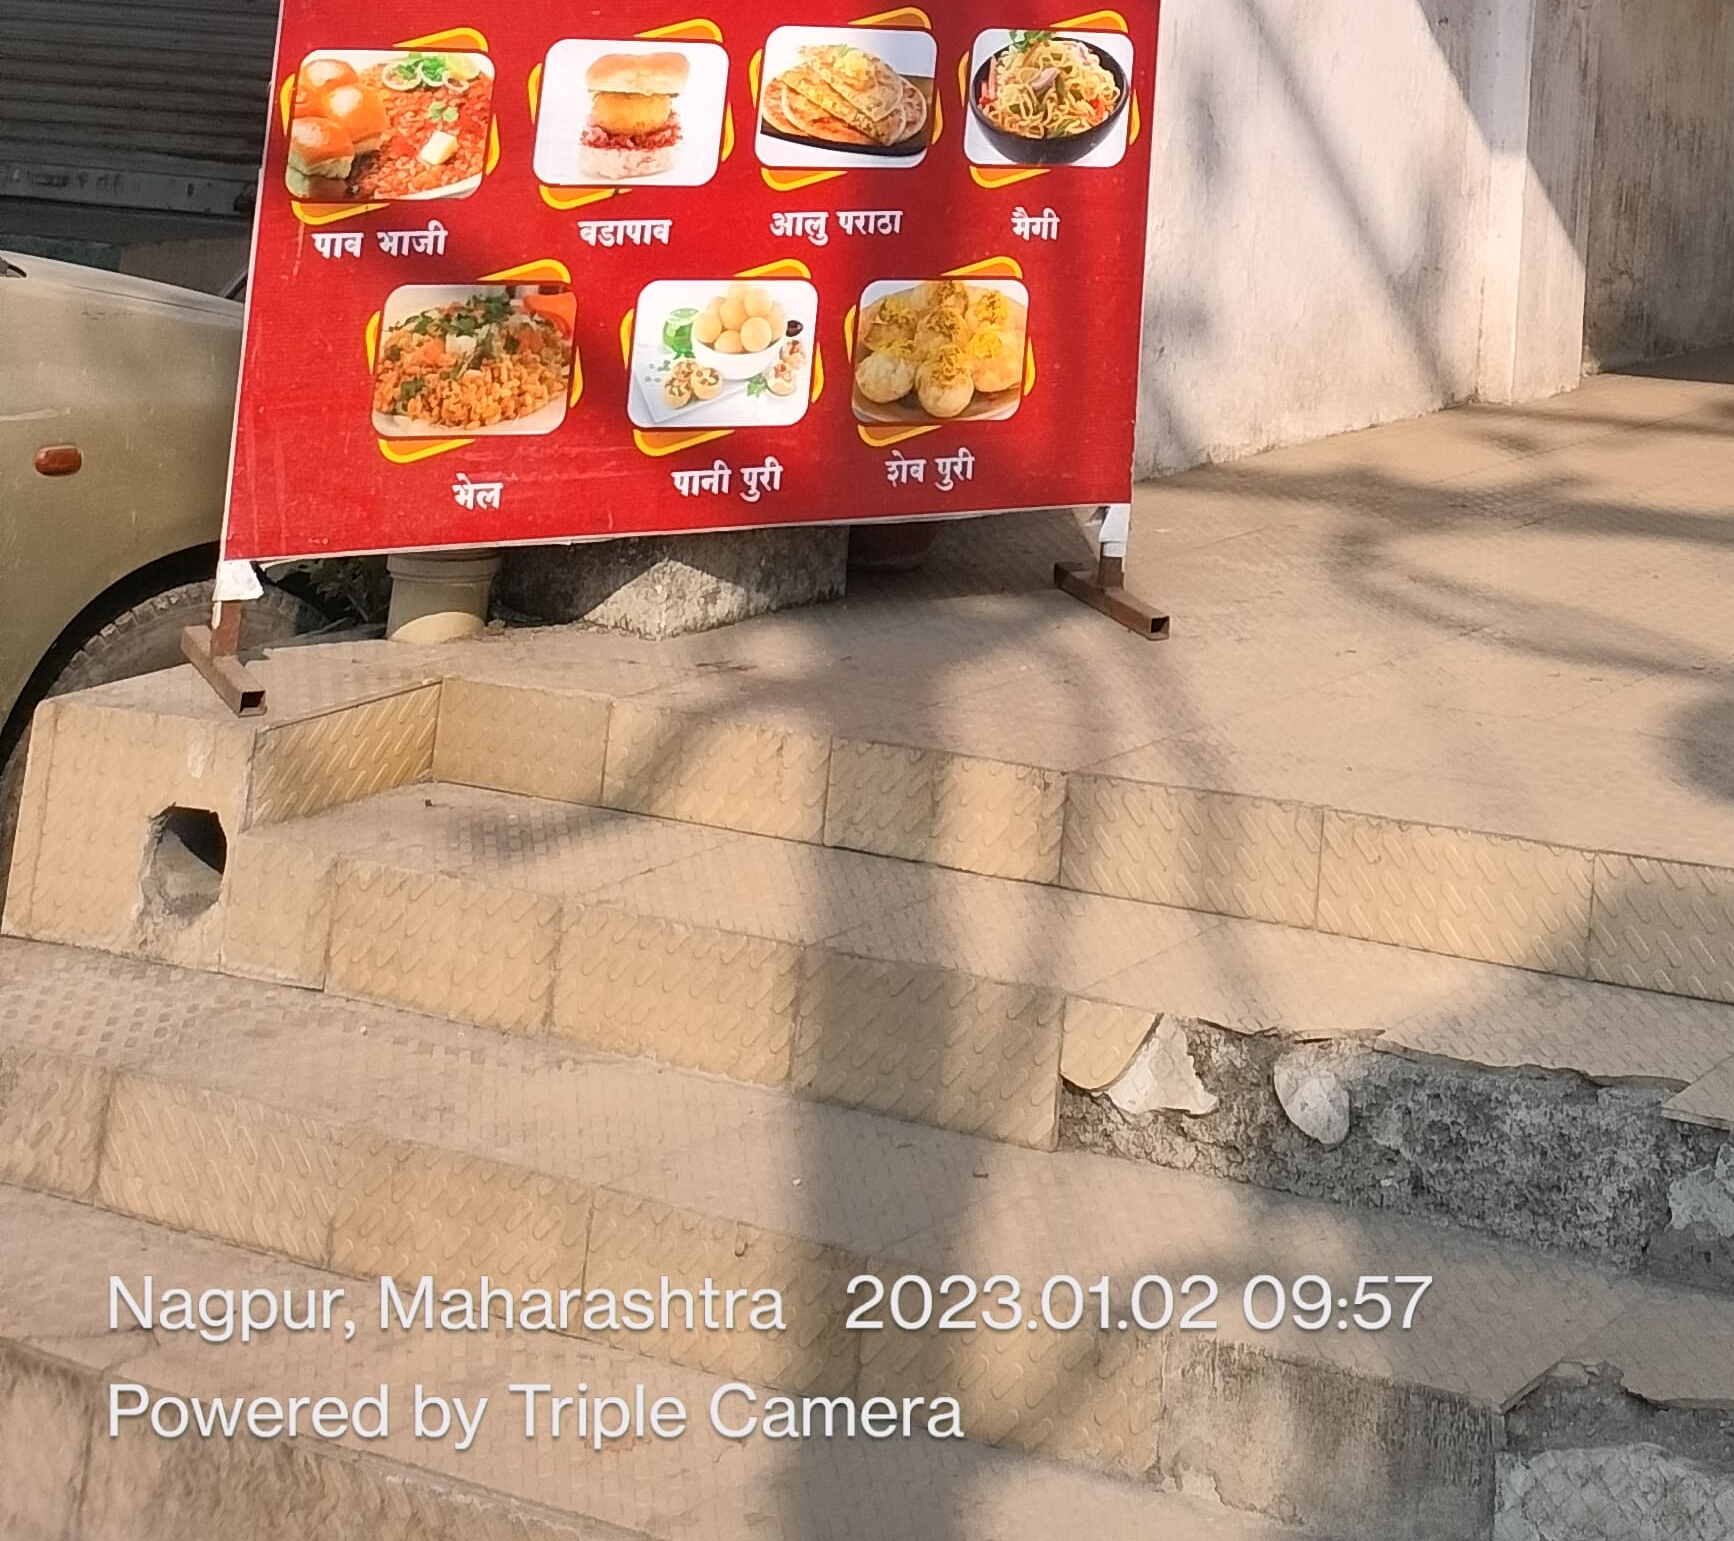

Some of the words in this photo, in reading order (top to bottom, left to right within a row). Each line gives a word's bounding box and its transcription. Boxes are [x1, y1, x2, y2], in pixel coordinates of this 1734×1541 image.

[311, 231, 364, 259] पाव
[377, 219, 448, 257] भाजी
[576, 218, 673, 248] वडापाव
[769, 210, 829, 246] आलु
[836, 210, 904, 235] पराठा
[1009, 206, 1061, 241] मैगी
[671, 459, 731, 498] पानी
[740, 455, 784, 503] पुरी
[885, 449, 927, 489] शेव
[934, 451, 976, 492] पुरी
[452, 473, 503, 511] भेल
